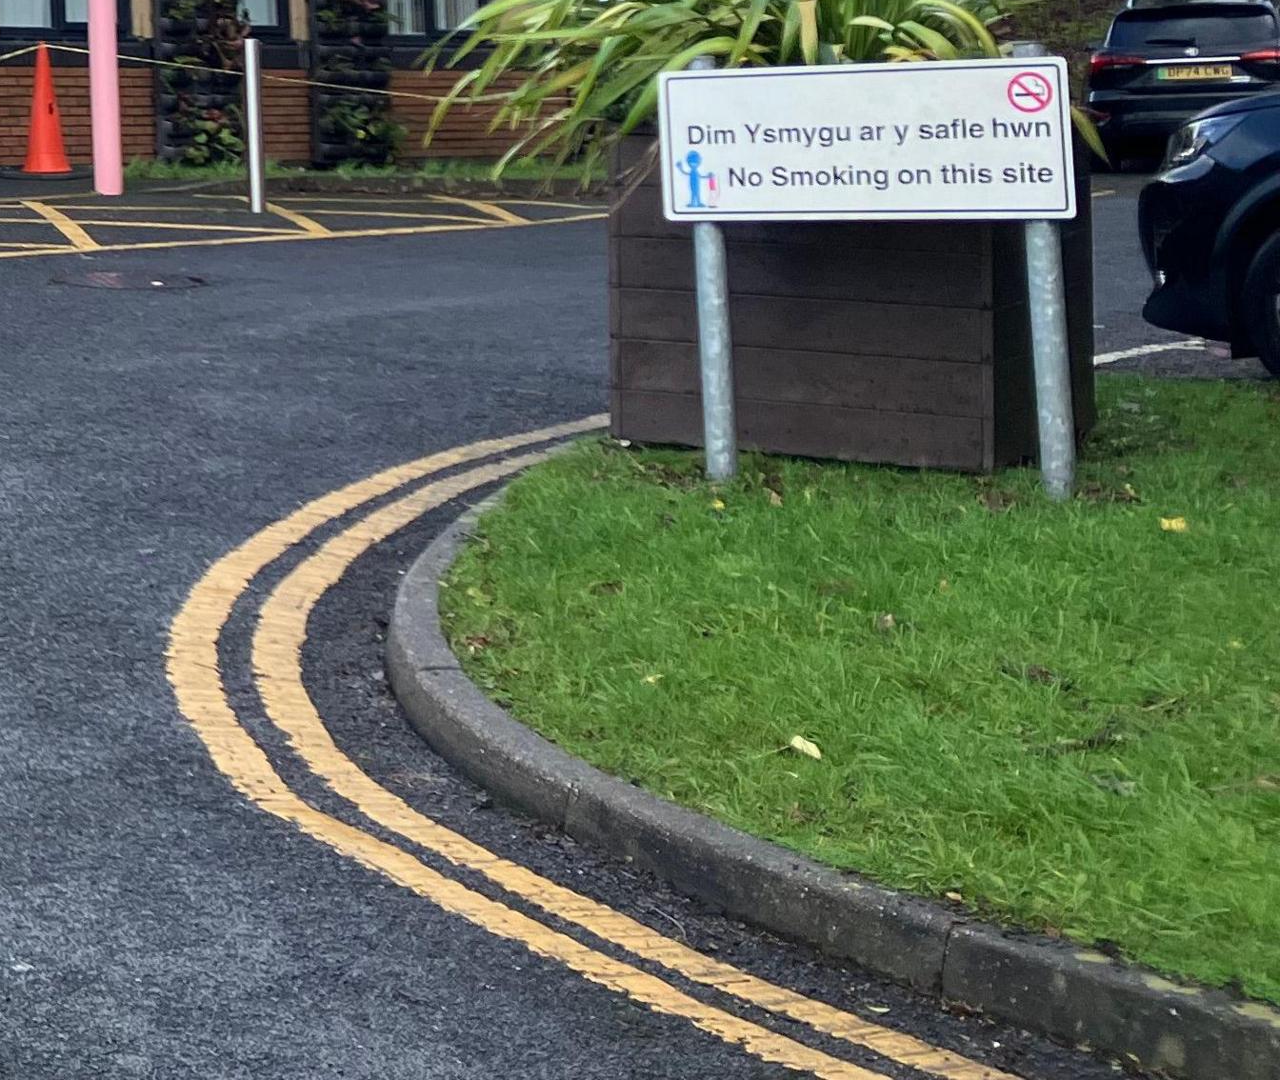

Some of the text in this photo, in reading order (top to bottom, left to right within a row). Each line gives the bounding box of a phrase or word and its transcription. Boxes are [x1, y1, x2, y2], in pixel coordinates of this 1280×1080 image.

[687, 118, 1052, 148] Dim Ysmygu ar y safle hwn
[728, 164, 1053, 190] No Smoking on this site
